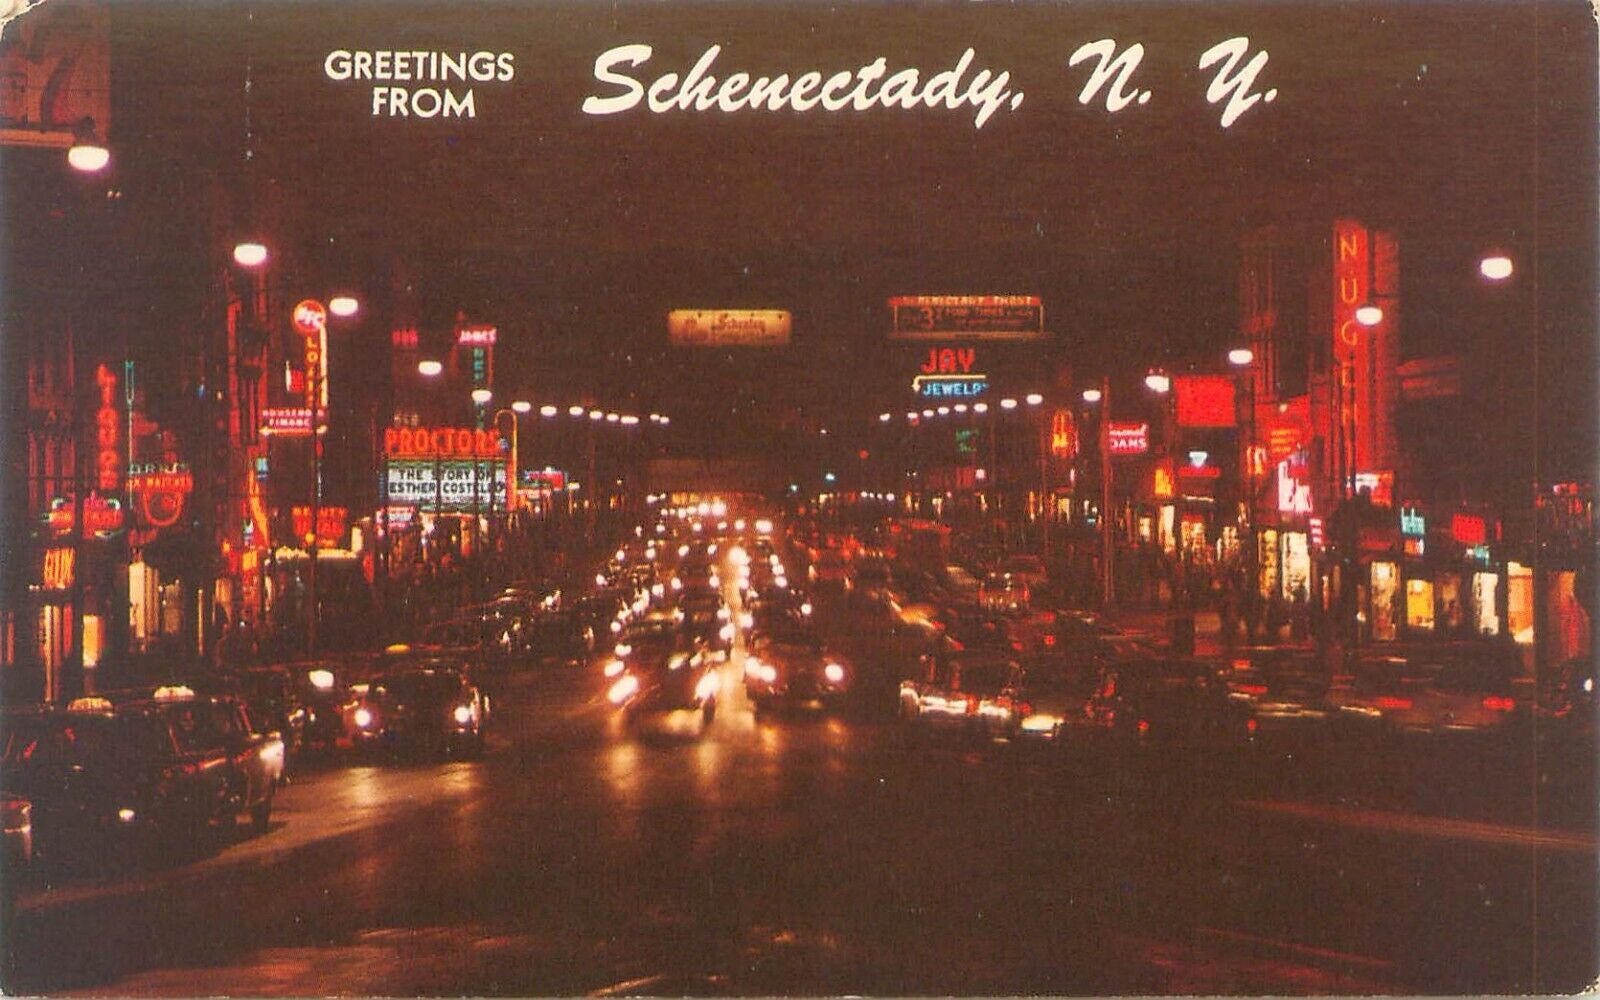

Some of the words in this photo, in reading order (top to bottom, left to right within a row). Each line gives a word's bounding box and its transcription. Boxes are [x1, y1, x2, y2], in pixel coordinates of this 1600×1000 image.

[921, 347, 976, 373] JAY
[269, 418, 312, 428] FINANC
[400, 468, 424, 480] THE
[433, 468, 471, 480] TORY
[389, 482, 436, 494] ESTHER
